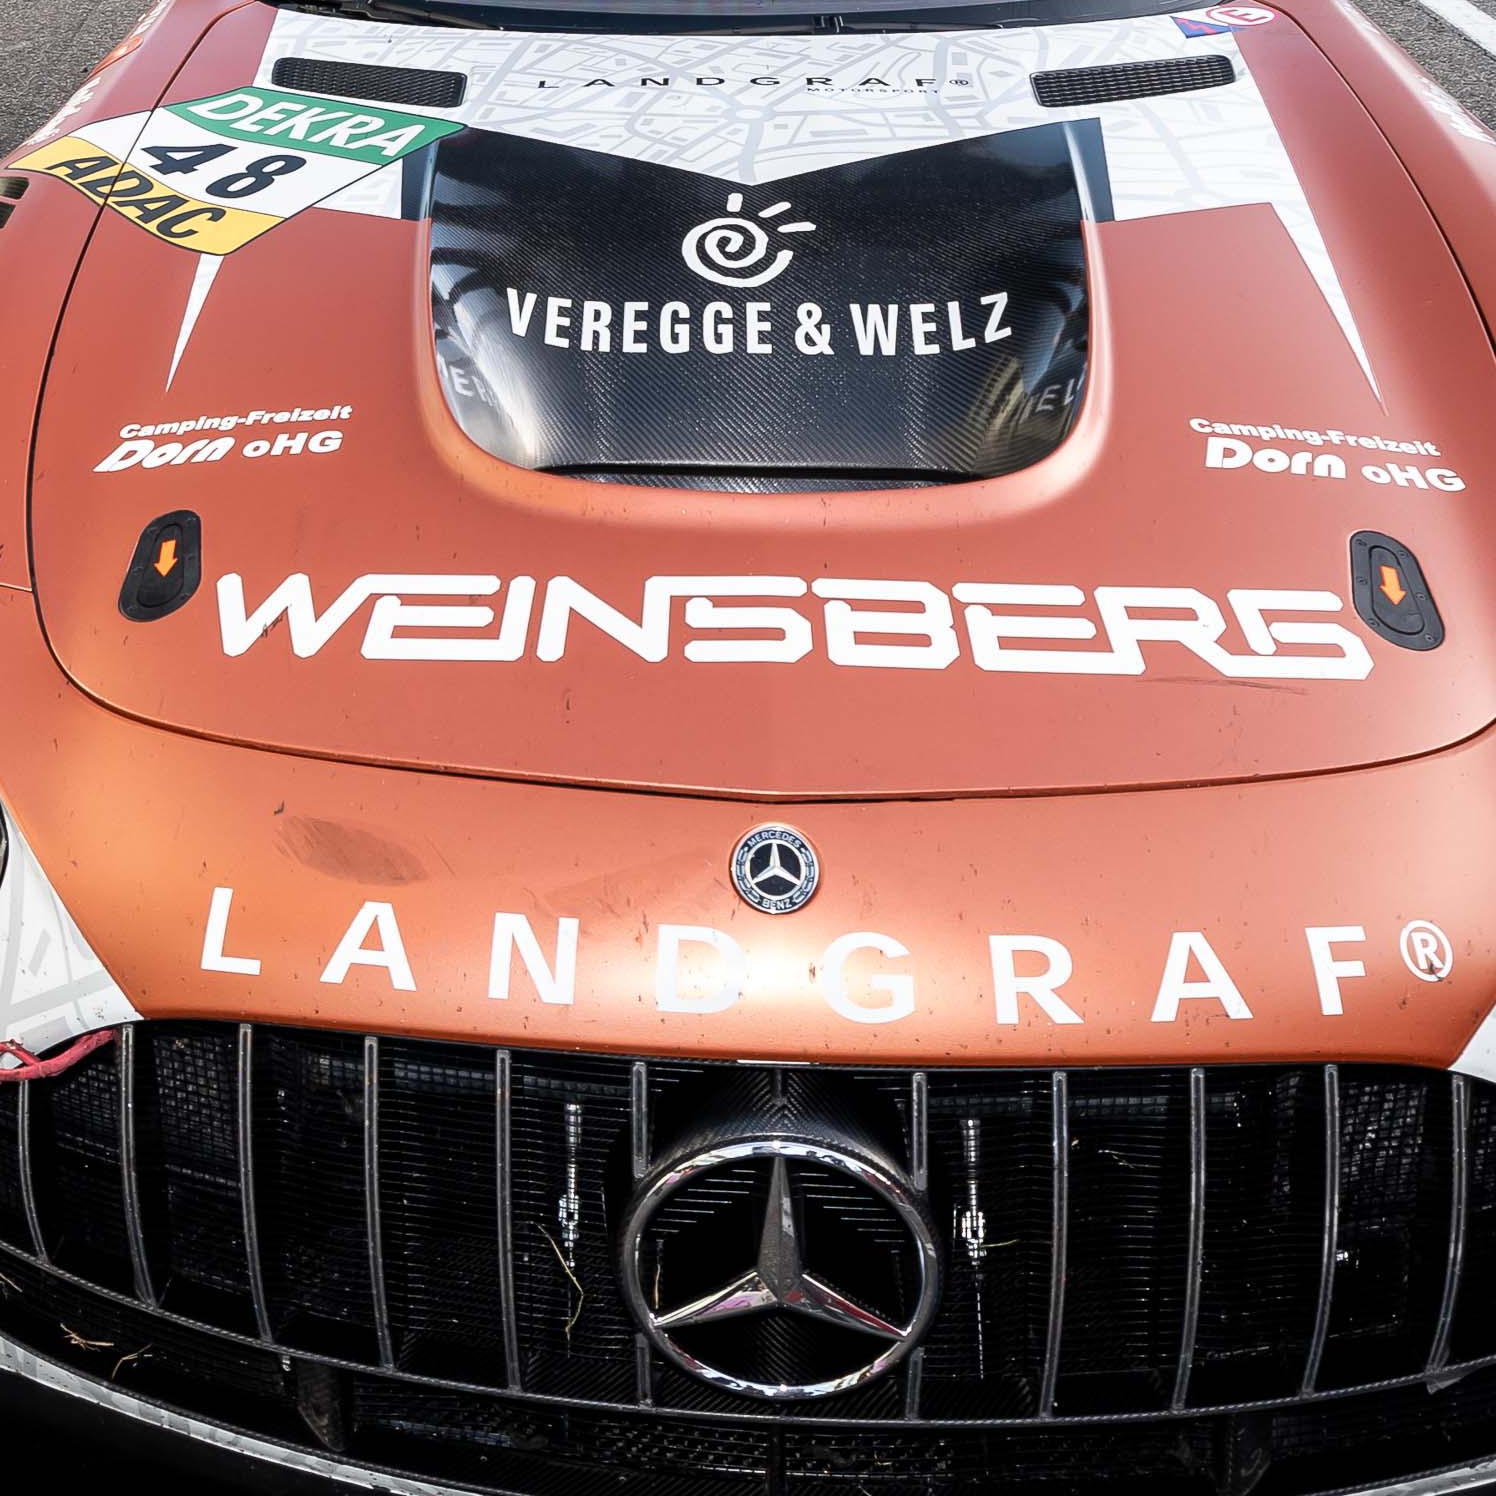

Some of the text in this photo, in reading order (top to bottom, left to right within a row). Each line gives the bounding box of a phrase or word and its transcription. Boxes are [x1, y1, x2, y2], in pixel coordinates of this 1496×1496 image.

[191, 92, 425, 158] DEKRA
[140, 143, 307, 200] 48
[47, 155, 226, 240] ADAC
[507, 287, 1012, 357] VEREGGE & WELZ
[119, 405, 353, 439] Camping-Freizeit
[1188, 417, 1442, 457] Camping-Freizeit
[92, 436, 236, 473] Dorn
[1205, 436, 1347, 479] Dorn
[216, 571, 1374, 682] WEINSBERG
[747, 830, 802, 848] MERCEDES
[762, 898, 793, 910] BENZ
